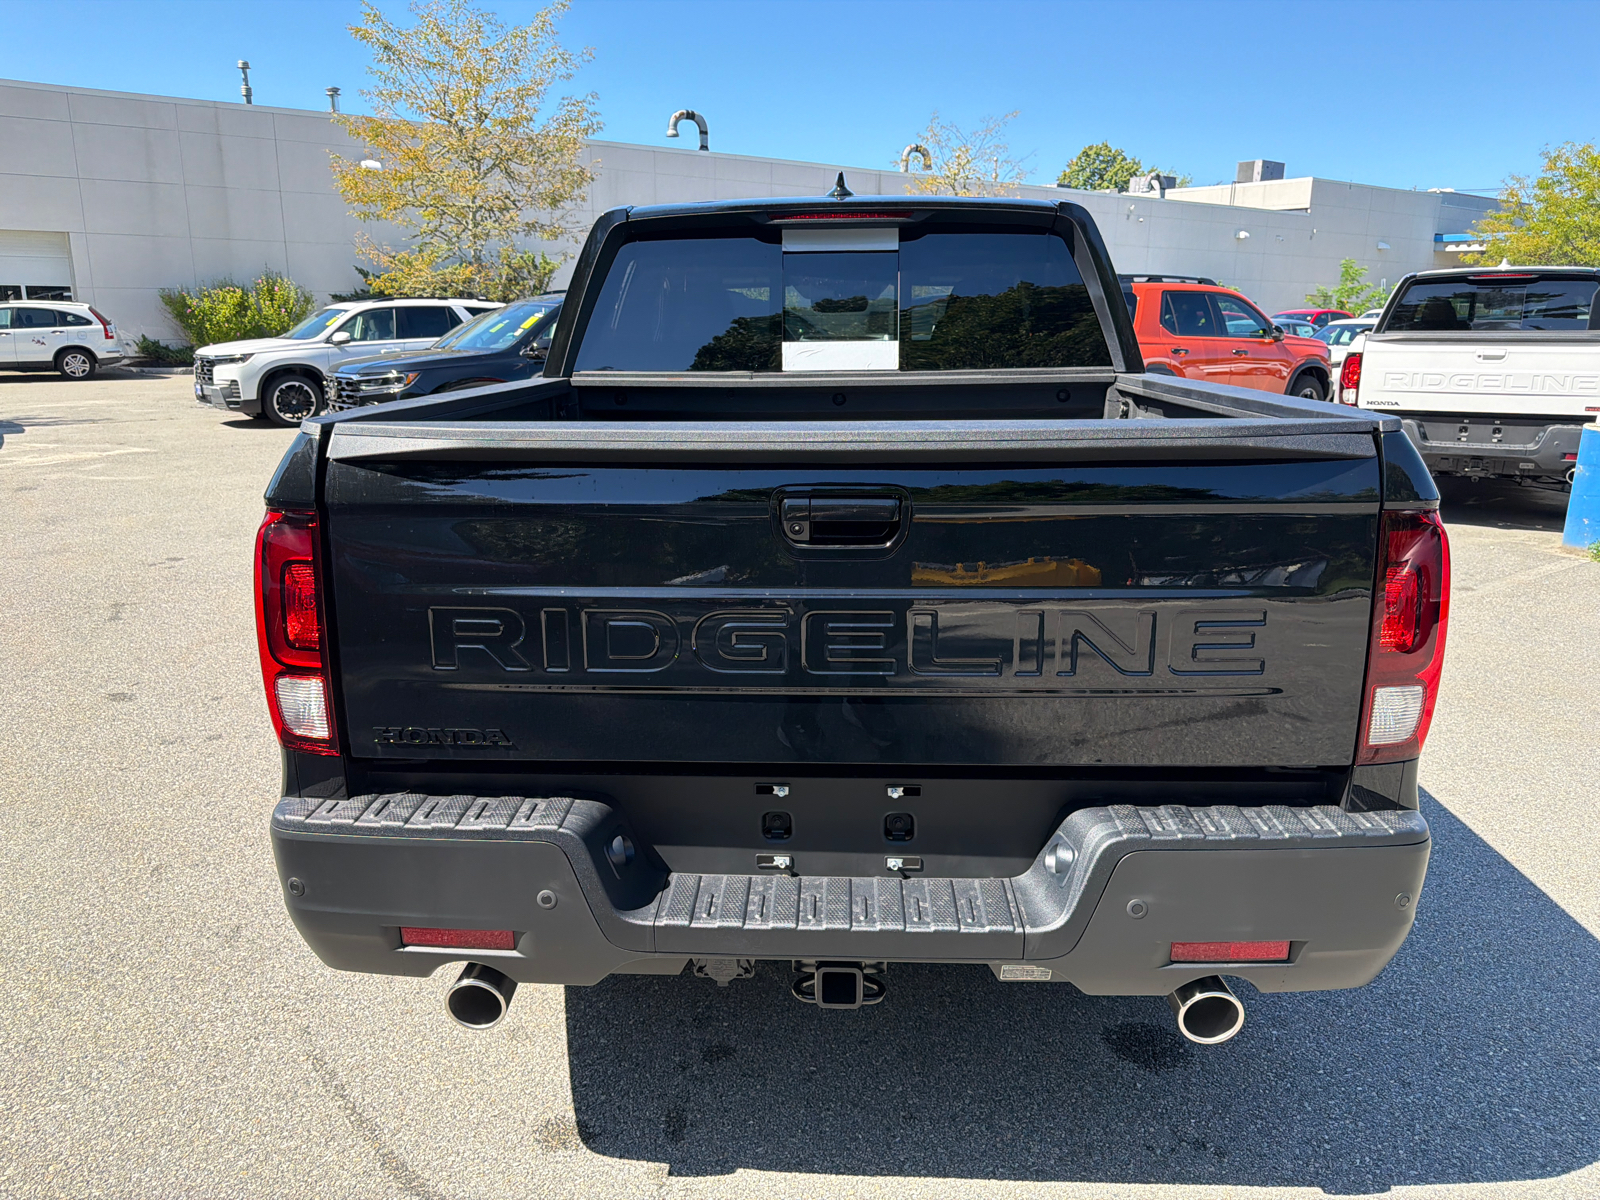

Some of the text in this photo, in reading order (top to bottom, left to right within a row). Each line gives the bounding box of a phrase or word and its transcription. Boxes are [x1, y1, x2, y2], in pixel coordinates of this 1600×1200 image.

[1383, 371, 1599, 393] RIDGELINE
[427, 605, 1267, 677] RIDGELINE
[372, 726, 514, 746] HONDA
